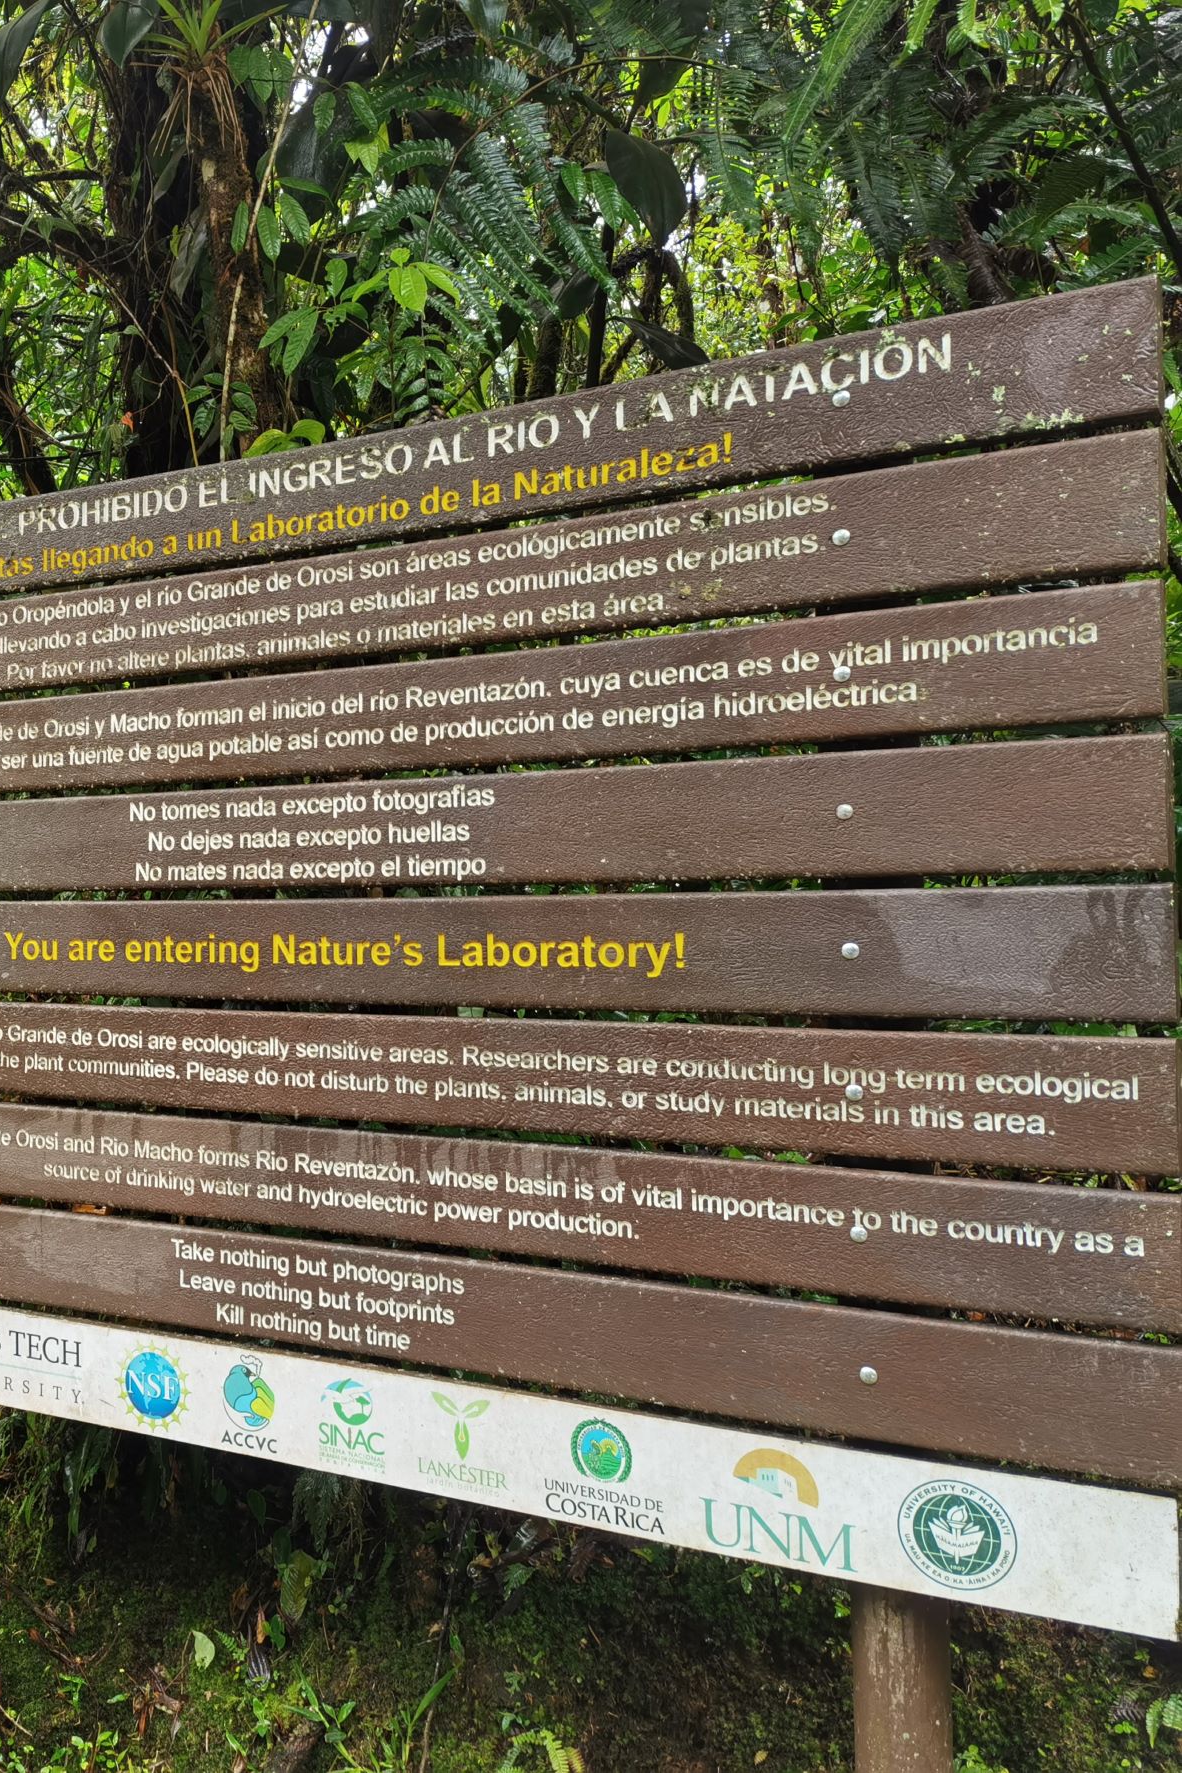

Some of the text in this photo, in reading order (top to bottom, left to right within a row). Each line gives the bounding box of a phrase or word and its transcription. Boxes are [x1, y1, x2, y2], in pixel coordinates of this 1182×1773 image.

[19, 483, 188, 535] PROHIBIDO
[197, 475, 232, 507] EL
[248, 442, 413, 498] INGRESO
[422, 430, 474, 468] AL
[572, 405, 600, 440] Y
[40, 534, 154, 571] llegando
[162, 534, 178, 555] a
[187, 527, 221, 552] un
[231, 493, 409, 545] Laboratorio
[419, 485, 460, 516] de
[470, 477, 501, 507] la
[513, 431, 732, 500] Naturaleza!
[11, 593, 114, 625] Oropéndola
[118, 594, 130, 615] y
[134, 587, 152, 609] el
[156, 583, 182, 606] río
[186, 574, 260, 603] Grande
[264, 570, 292, 592] de
[296, 559, 352, 588] Orosi
[359, 557, 400, 579] son
[404, 547, 470, 573] áreas
[476, 513, 680, 563] ecológicamente
[128, 801, 156, 822] No
[160, 800, 220, 820] tomes
[224, 795, 276, 818] nada
[281, 791, 367, 818] excepto
[147, 819, 469, 854] No dejes nada excepto huellas
[134, 854, 486, 882] No mates nada excepto el tiempo
[3, 931, 685, 975] You are entering Nature's Laboratory!
[6, 1023, 67, 1045] Grande
[70, 1026, 92, 1046] de
[95, 1027, 143, 1049] Orosi
[146, 1034, 176, 1051] are
[180, 1032, 289, 1061] ecologically
[294, 1038, 383, 1062] sensitive
[387, 1045, 453, 1065] areas.
[461, 1045, 609, 1073] Researchers
[616, 1056, 658, 1075] are
[665, 1056, 814, 1088] conducting
[974, 1069, 1138, 1101] ecological
[170, 1238, 465, 1296] Take nothing but photographs
[178, 1269, 454, 1325] Leave nothing but footprints
[215, 1302, 410, 1351] Kill nothing but time
[8, 1330, 83, 1368] TECH
[127, 1369, 179, 1401] NSF
[221, 1429, 278, 1454] ACCVC
[318, 1421, 385, 1456] SINAC
[544, 1477, 664, 1513] UNIVERSIDAD DE
[545, 1492, 665, 1535] COSTA RICA
[903, 1484, 956, 1519] UNIVERSITY
[961, 1487, 978, 1497] OF
[698, 1496, 859, 1573] UNM
